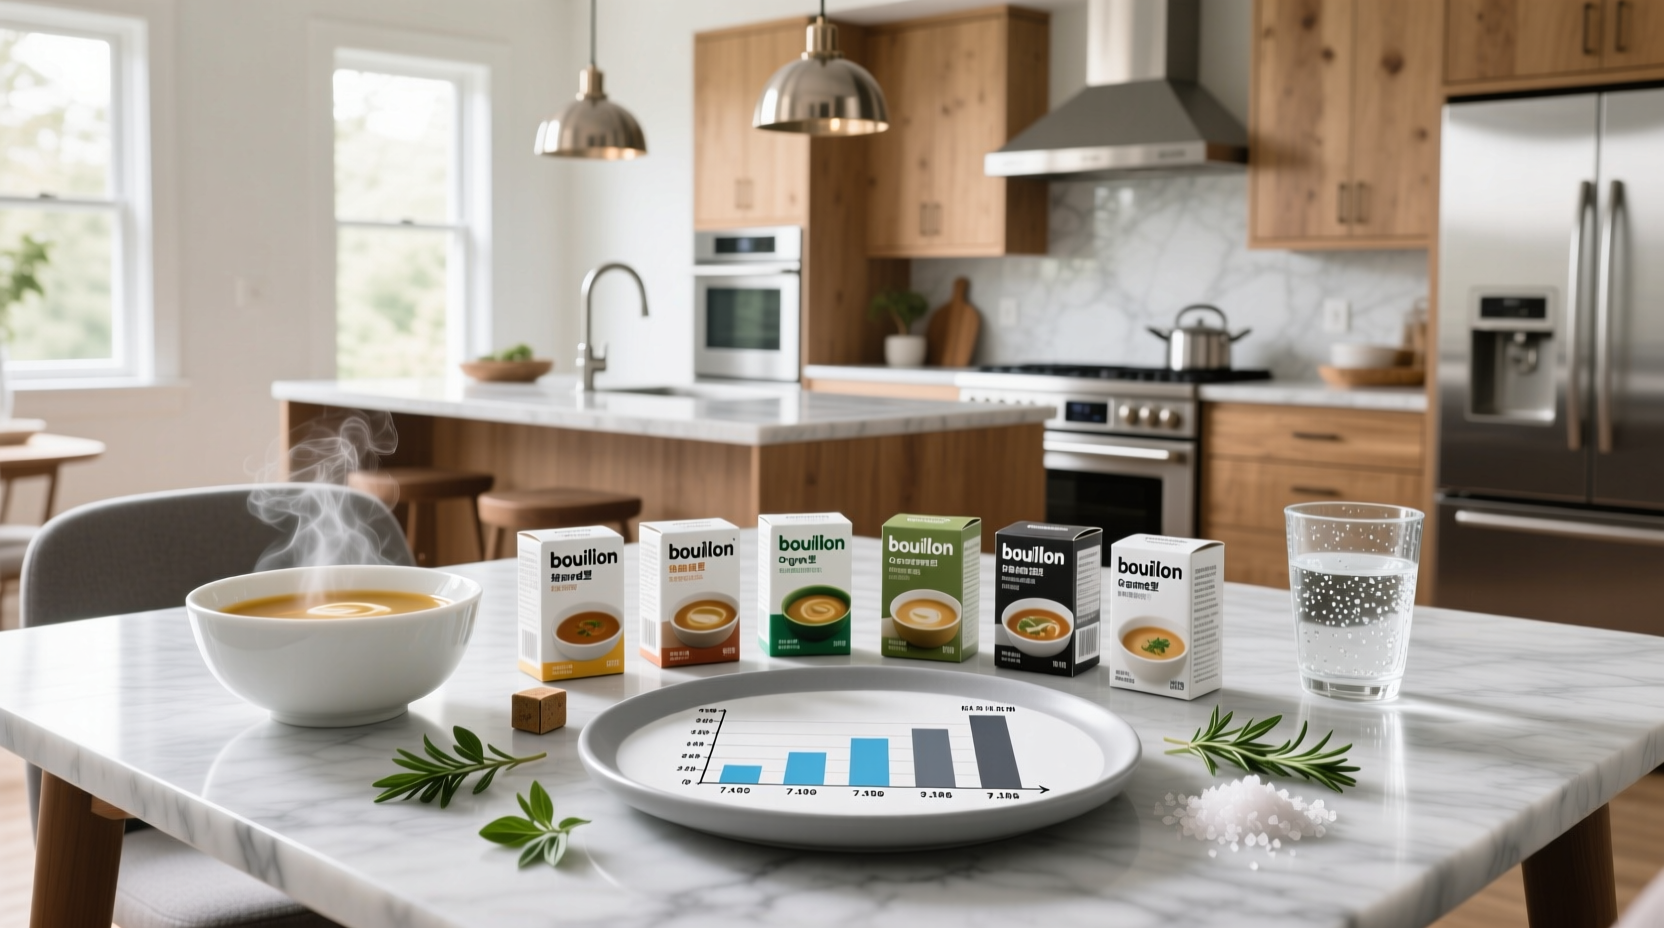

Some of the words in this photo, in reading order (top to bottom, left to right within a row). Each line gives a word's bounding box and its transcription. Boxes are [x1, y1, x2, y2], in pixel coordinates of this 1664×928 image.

[669, 541, 734, 560] bouillon
[779, 534, 845, 551] bouillon
[889, 535, 953, 556] bouillon
[1002, 543, 1065, 565] bouillon
[1118, 556, 1183, 580] bouillon
